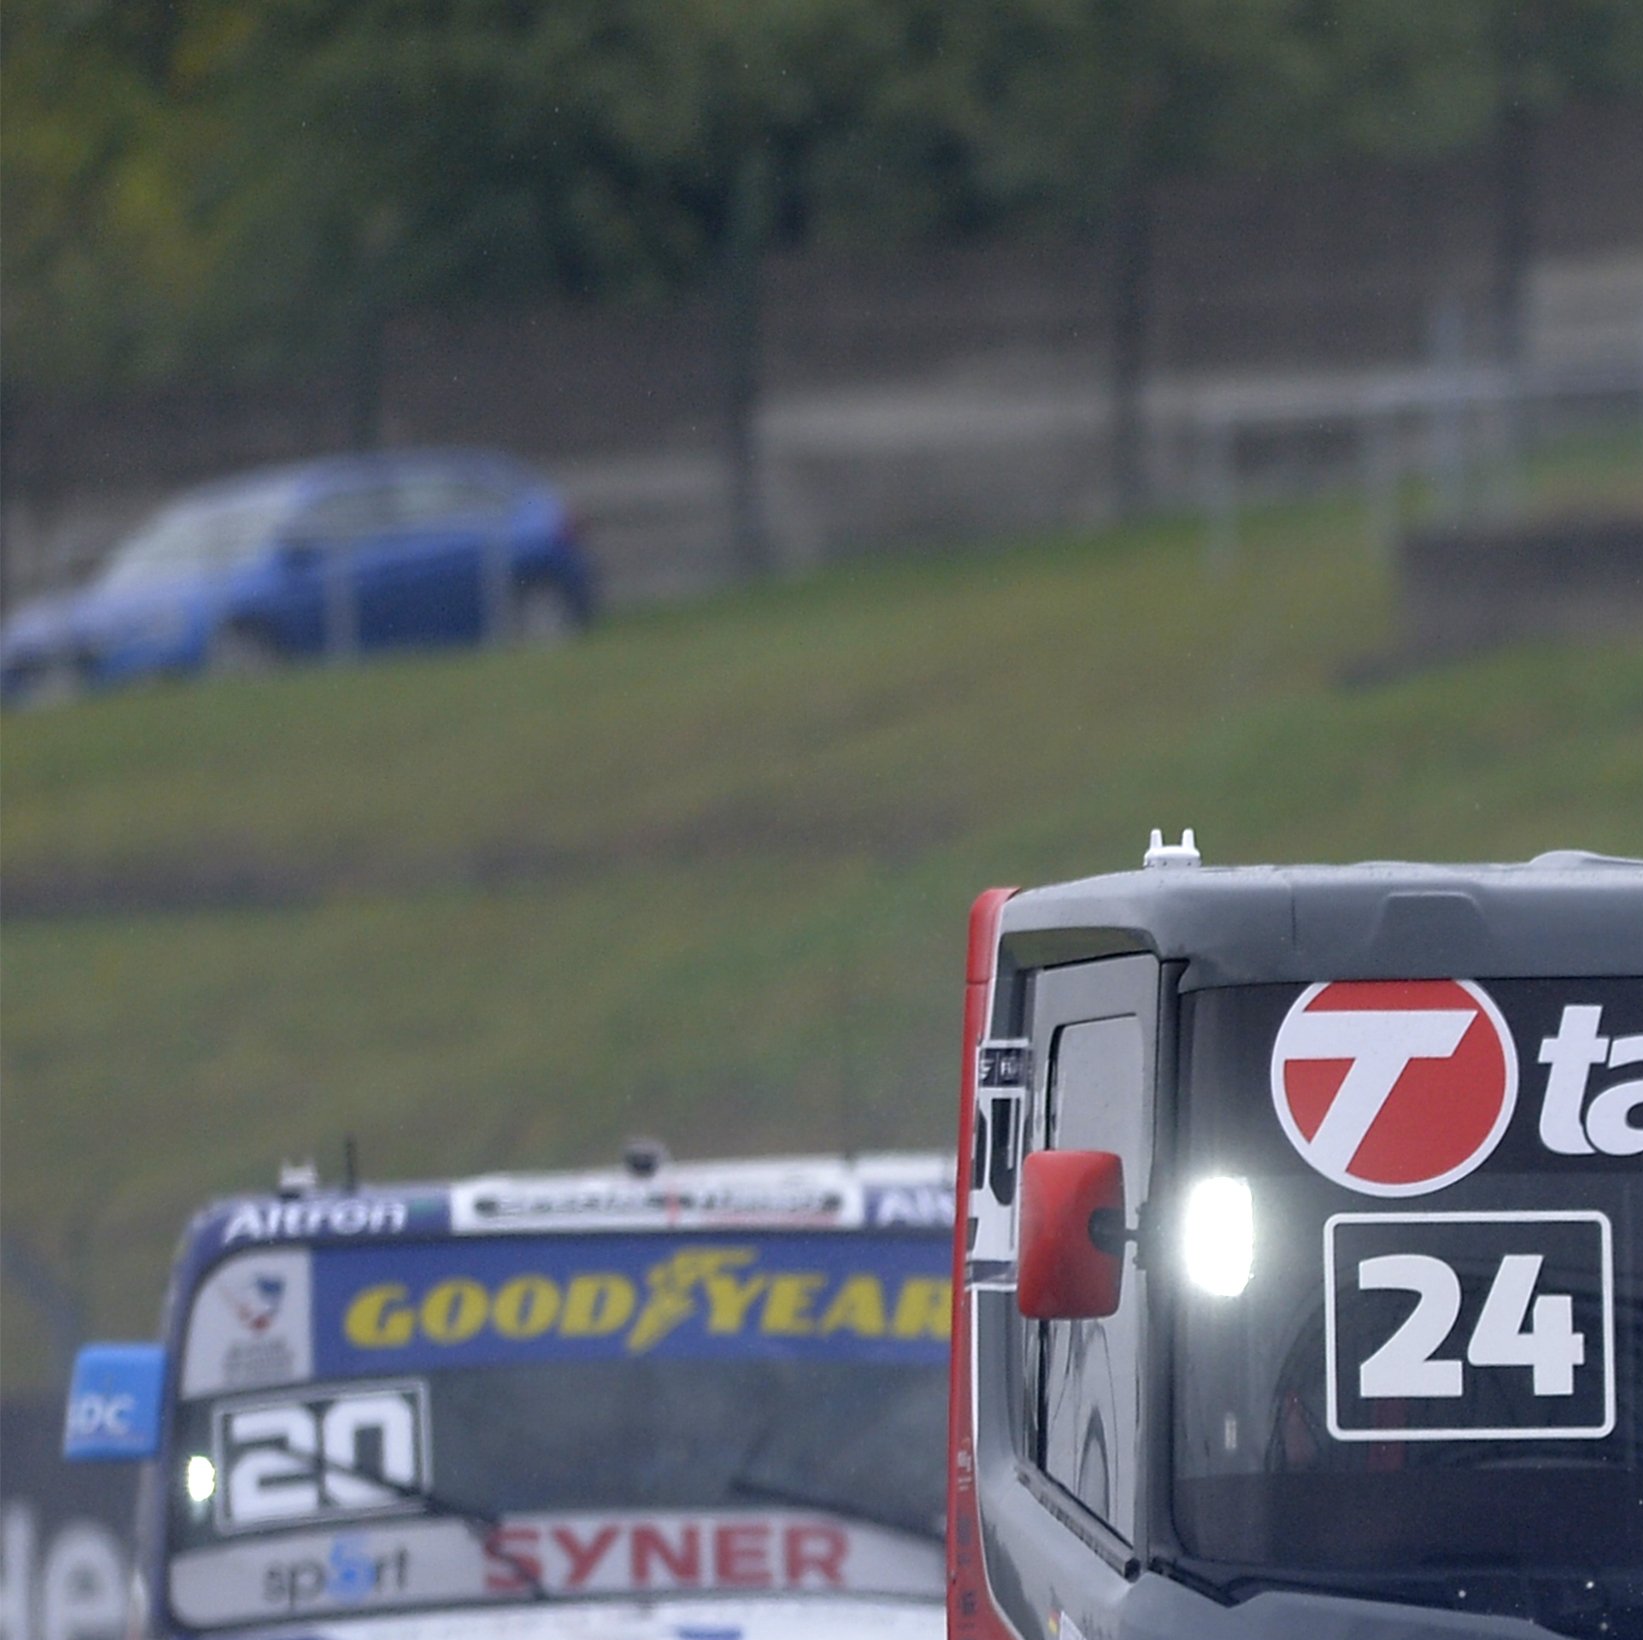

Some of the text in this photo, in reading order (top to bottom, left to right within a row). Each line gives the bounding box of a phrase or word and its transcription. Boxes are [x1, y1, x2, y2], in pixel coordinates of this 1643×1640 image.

[1358, 1253, 1586, 1399] 24
[222, 1392, 416, 1523] 20
[483, 1523, 850, 1593] SYNER
